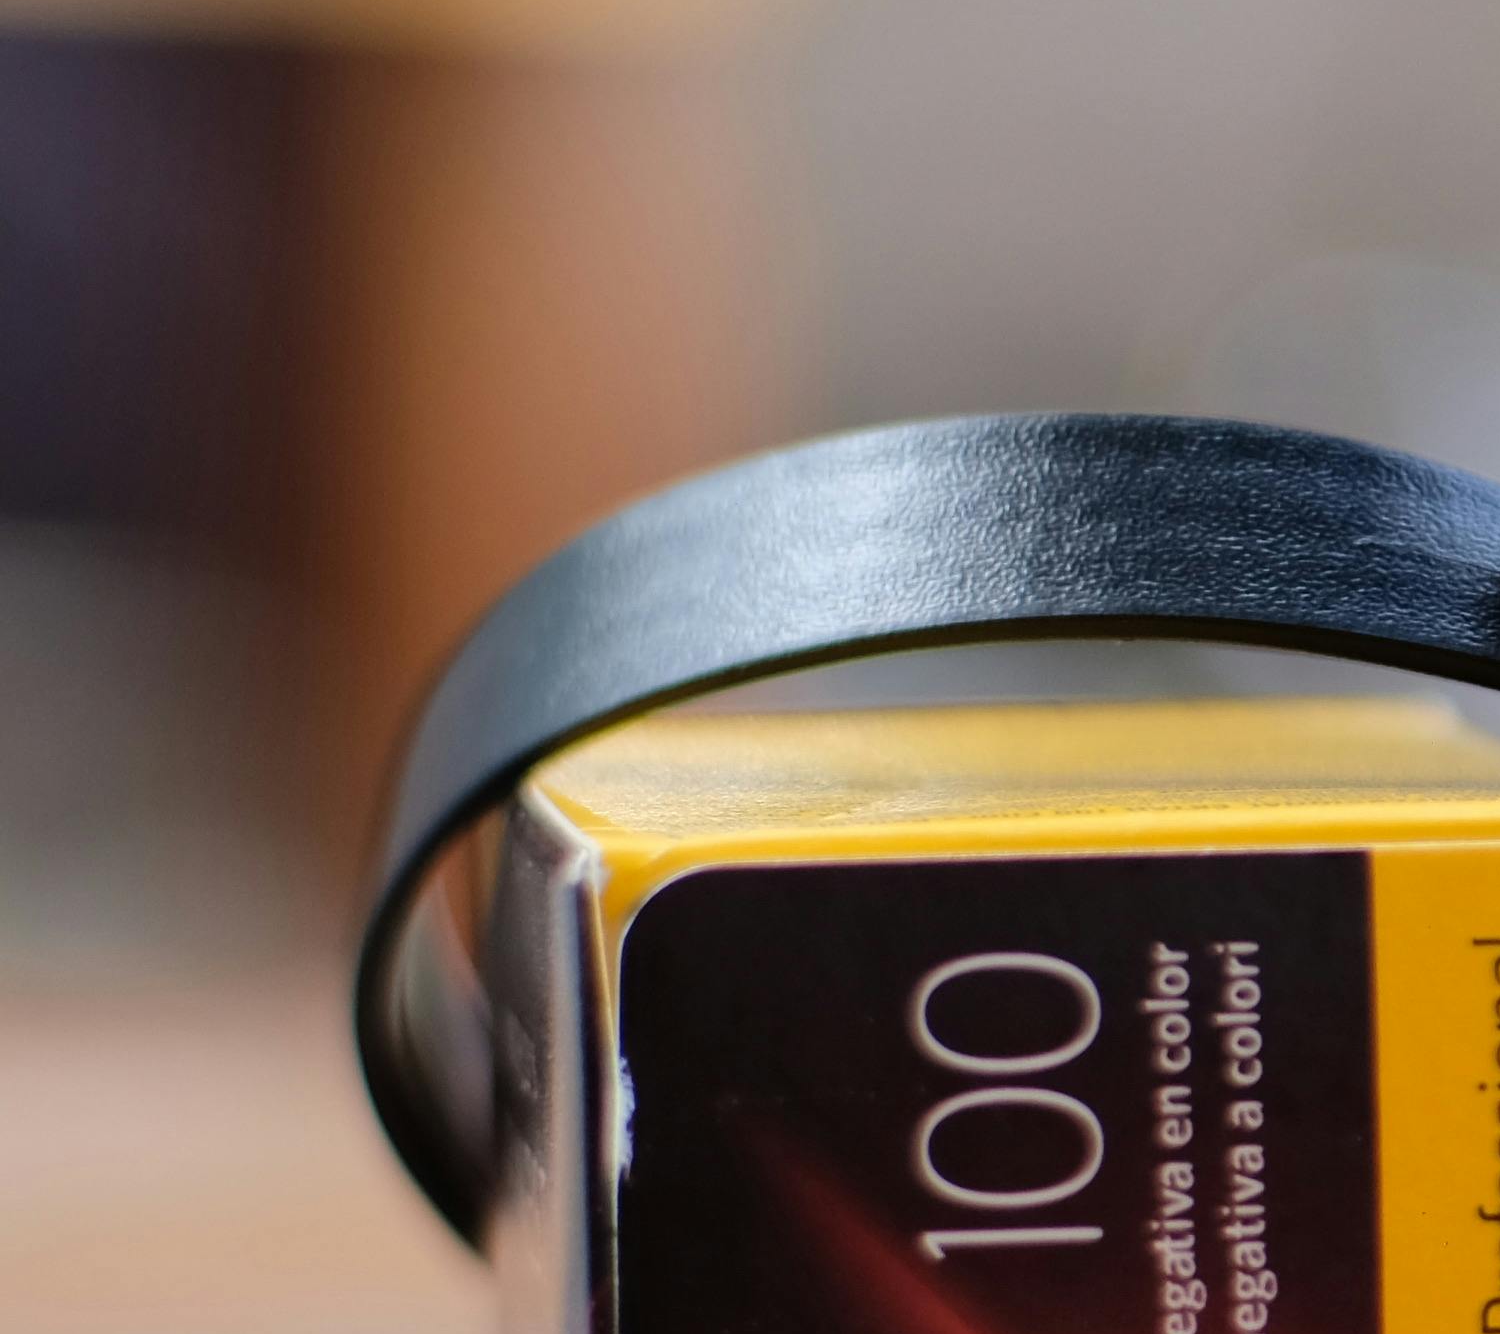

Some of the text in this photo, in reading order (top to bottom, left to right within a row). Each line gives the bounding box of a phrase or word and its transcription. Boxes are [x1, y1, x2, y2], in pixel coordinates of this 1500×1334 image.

[1140, 940, 1192, 1073] color
[1209, 940, 1264, 1087] colori
[907, 950, 1105, 1260] 100
[1154, 1084, 1194, 1150] en
[1228, 1099, 1265, 1132] a
